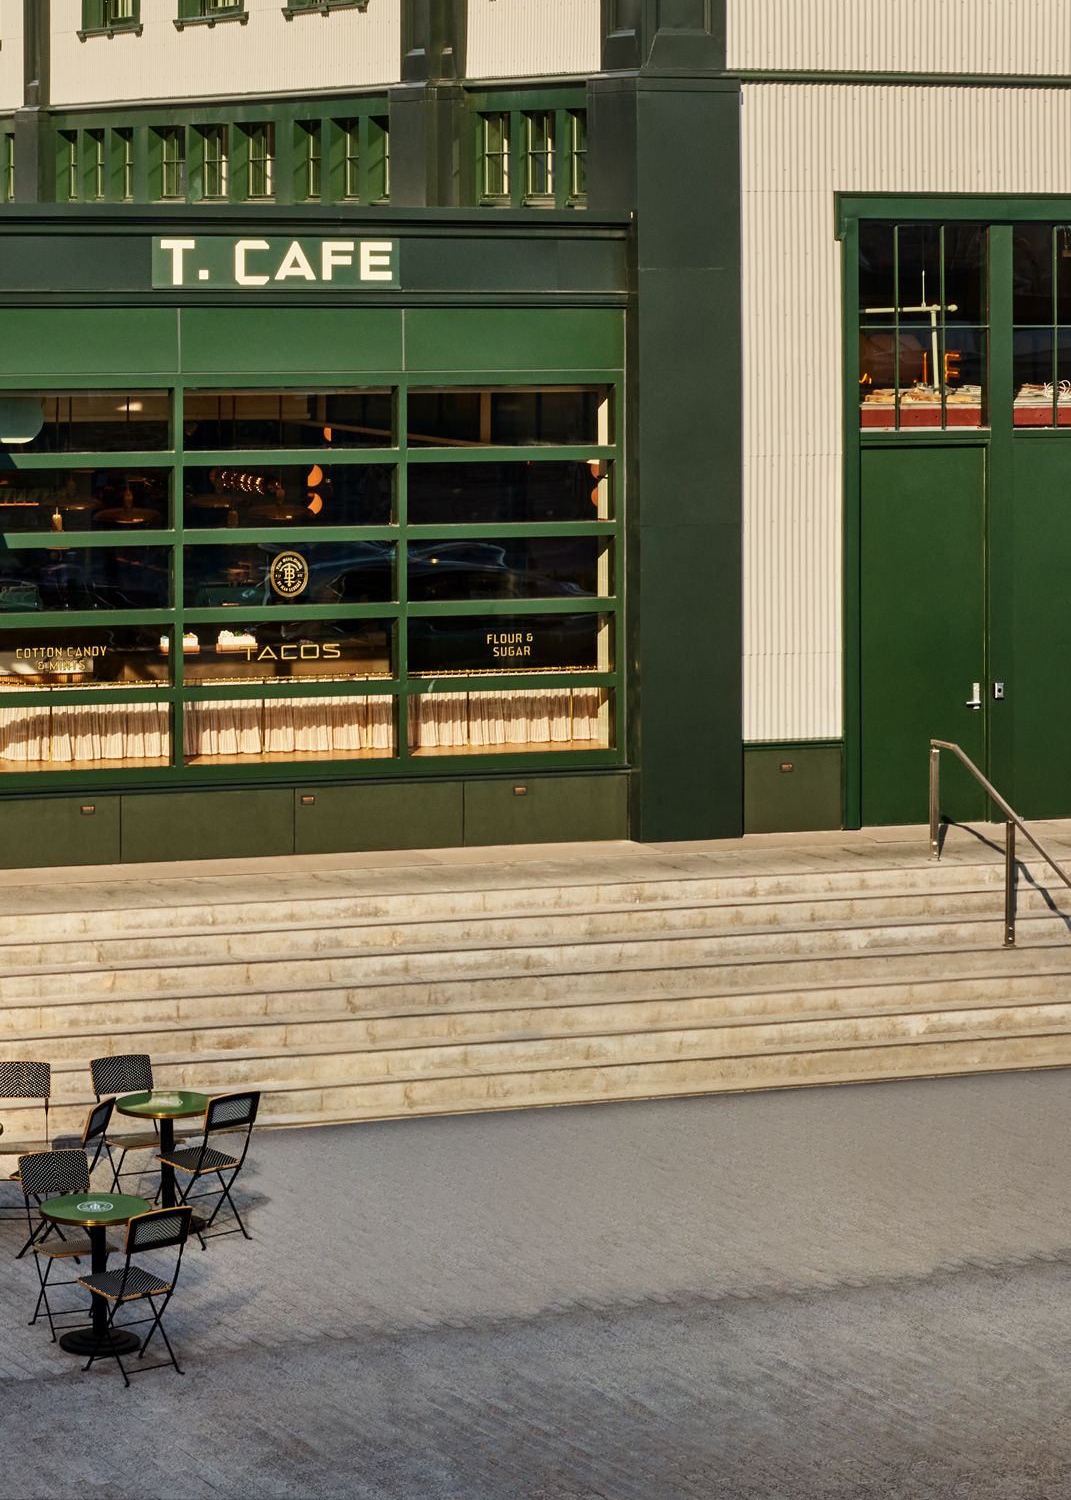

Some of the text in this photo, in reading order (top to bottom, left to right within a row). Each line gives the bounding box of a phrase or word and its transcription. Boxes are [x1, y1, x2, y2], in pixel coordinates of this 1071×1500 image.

[160, 239, 393, 286] T. CAFE
[486, 632, 534, 645] FLOUR &
[15, 645, 107, 659] COTTON CANDY
[239, 643, 341, 661] TACOS
[493, 645, 531, 657] SUGAR
[37, 660, 86, 671] & MINTS
